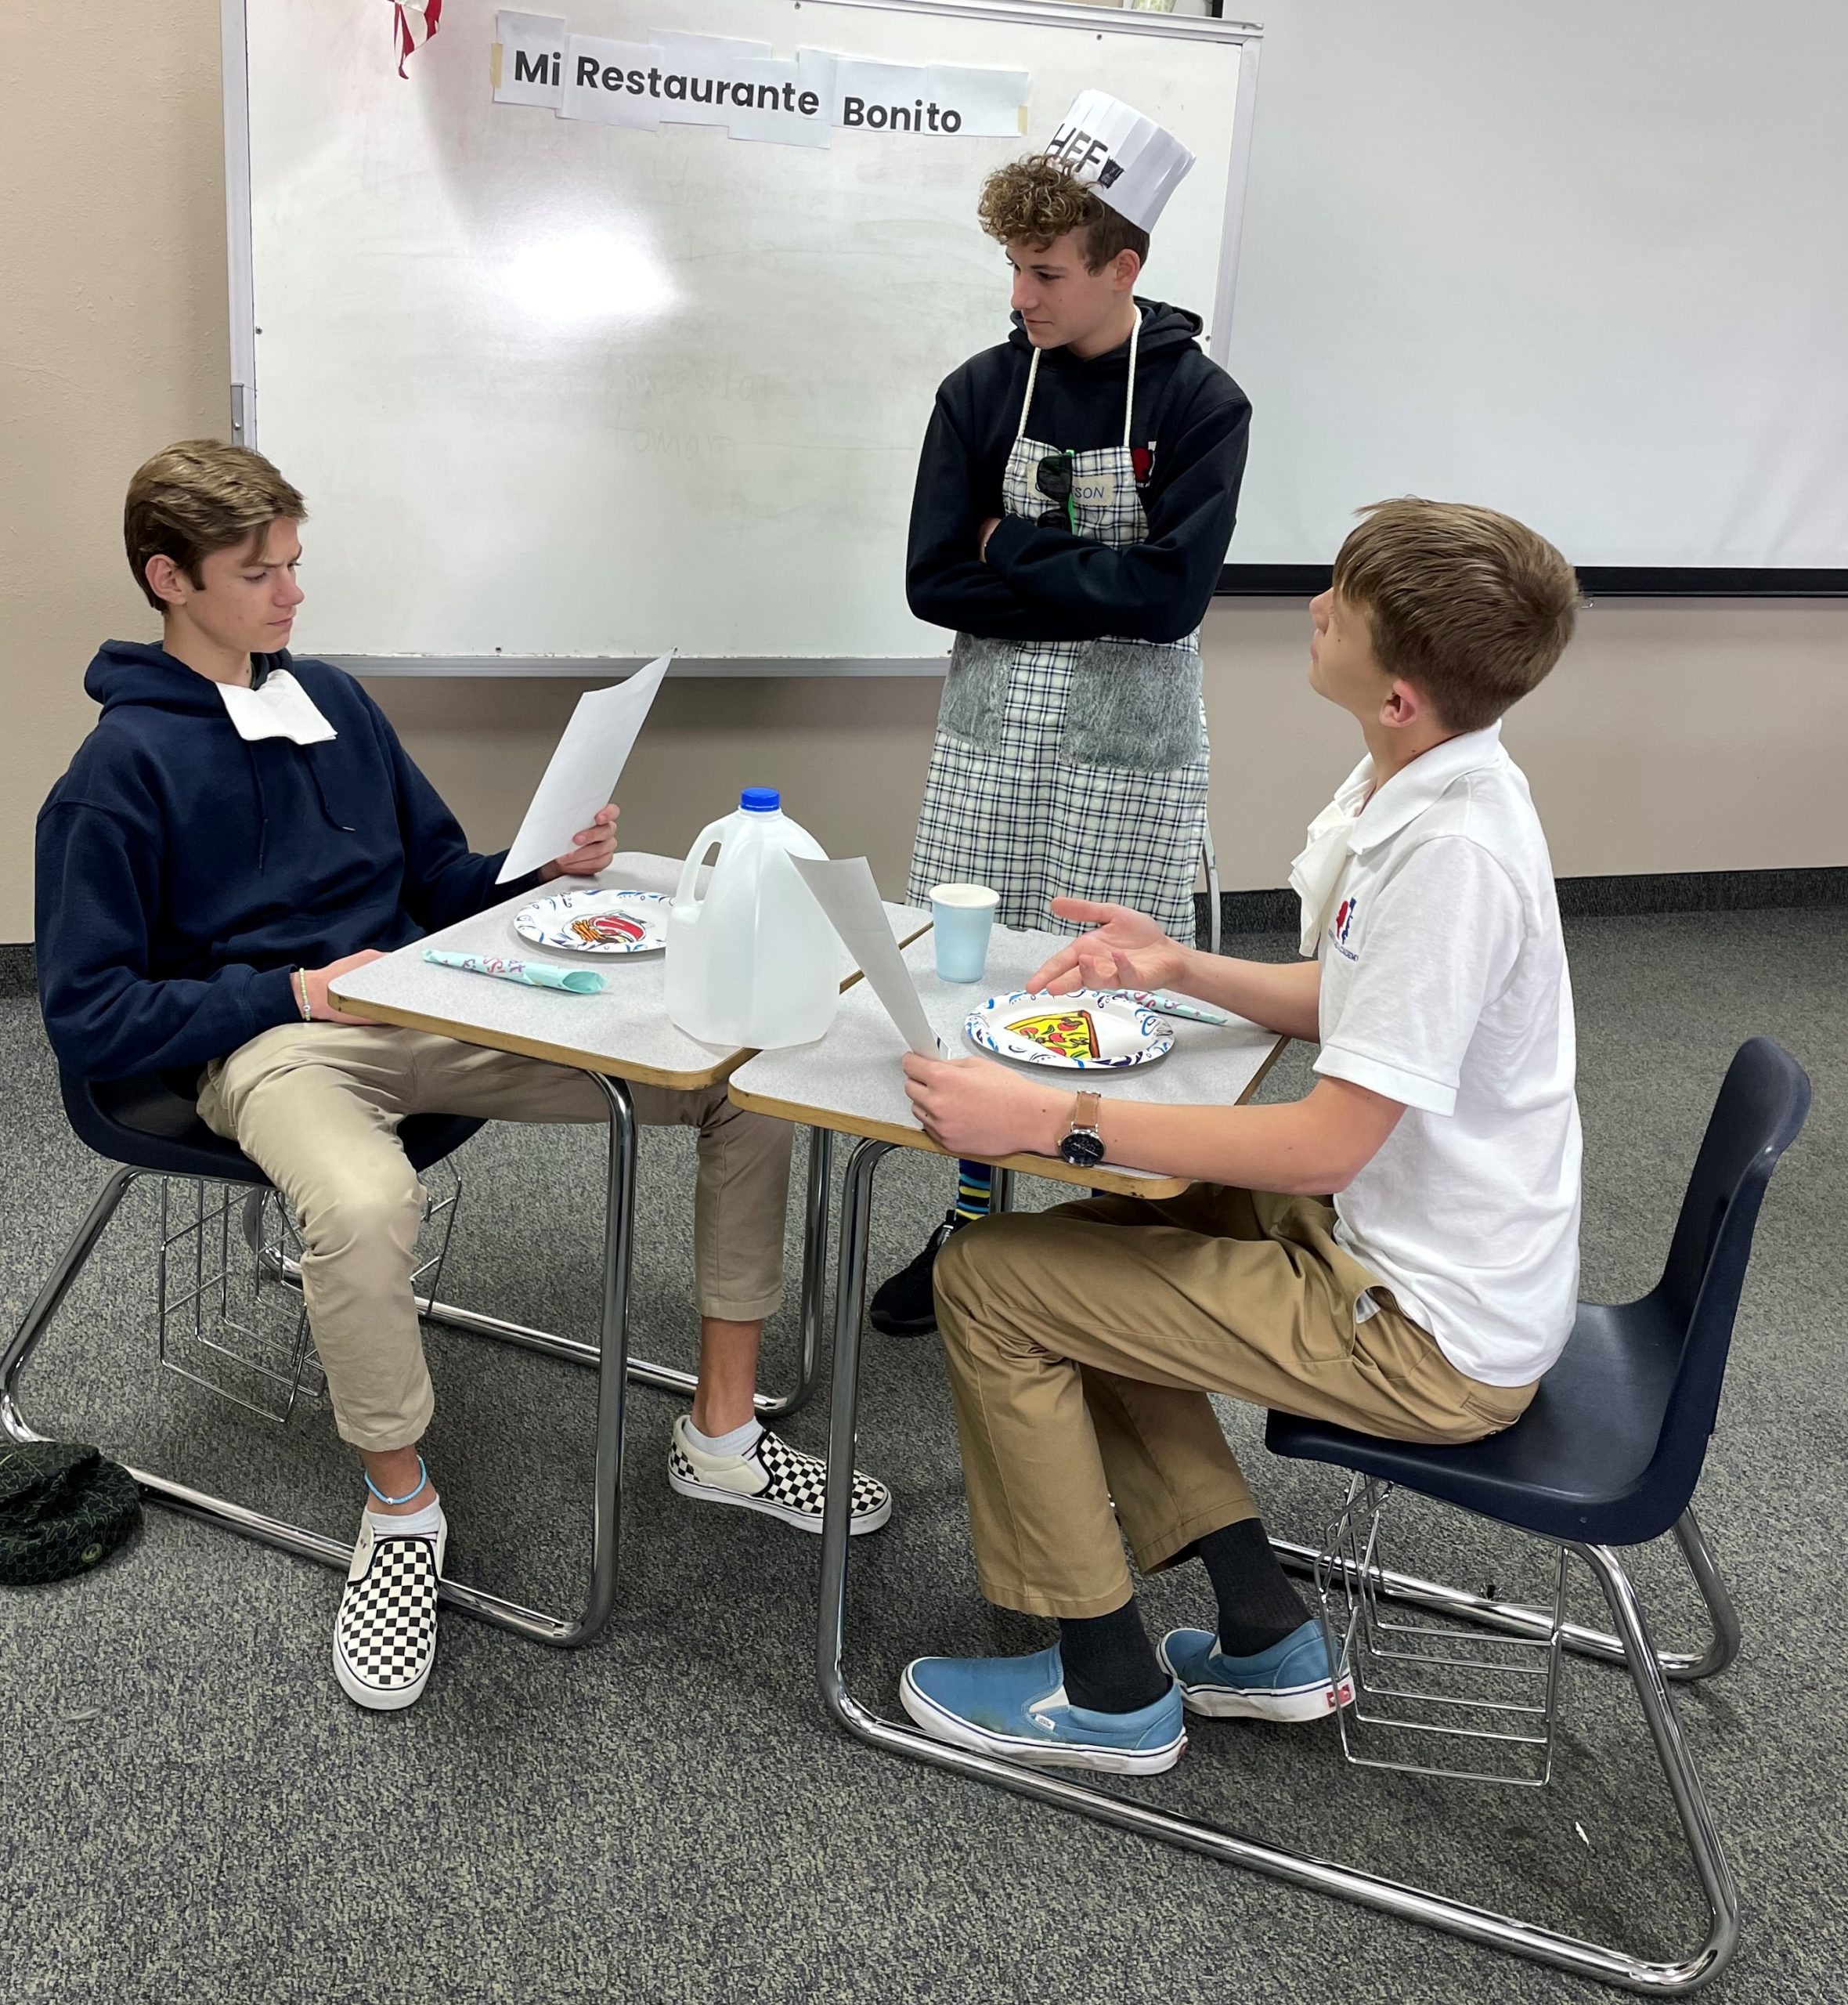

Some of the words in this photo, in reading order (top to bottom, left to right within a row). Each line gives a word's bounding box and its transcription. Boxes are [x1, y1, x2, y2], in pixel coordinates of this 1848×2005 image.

[514, 50, 561, 86] Mi
[576, 56, 819, 115] Restaurante
[843, 96, 962, 133] Bonito
[1045, 122, 1109, 173] HEF
